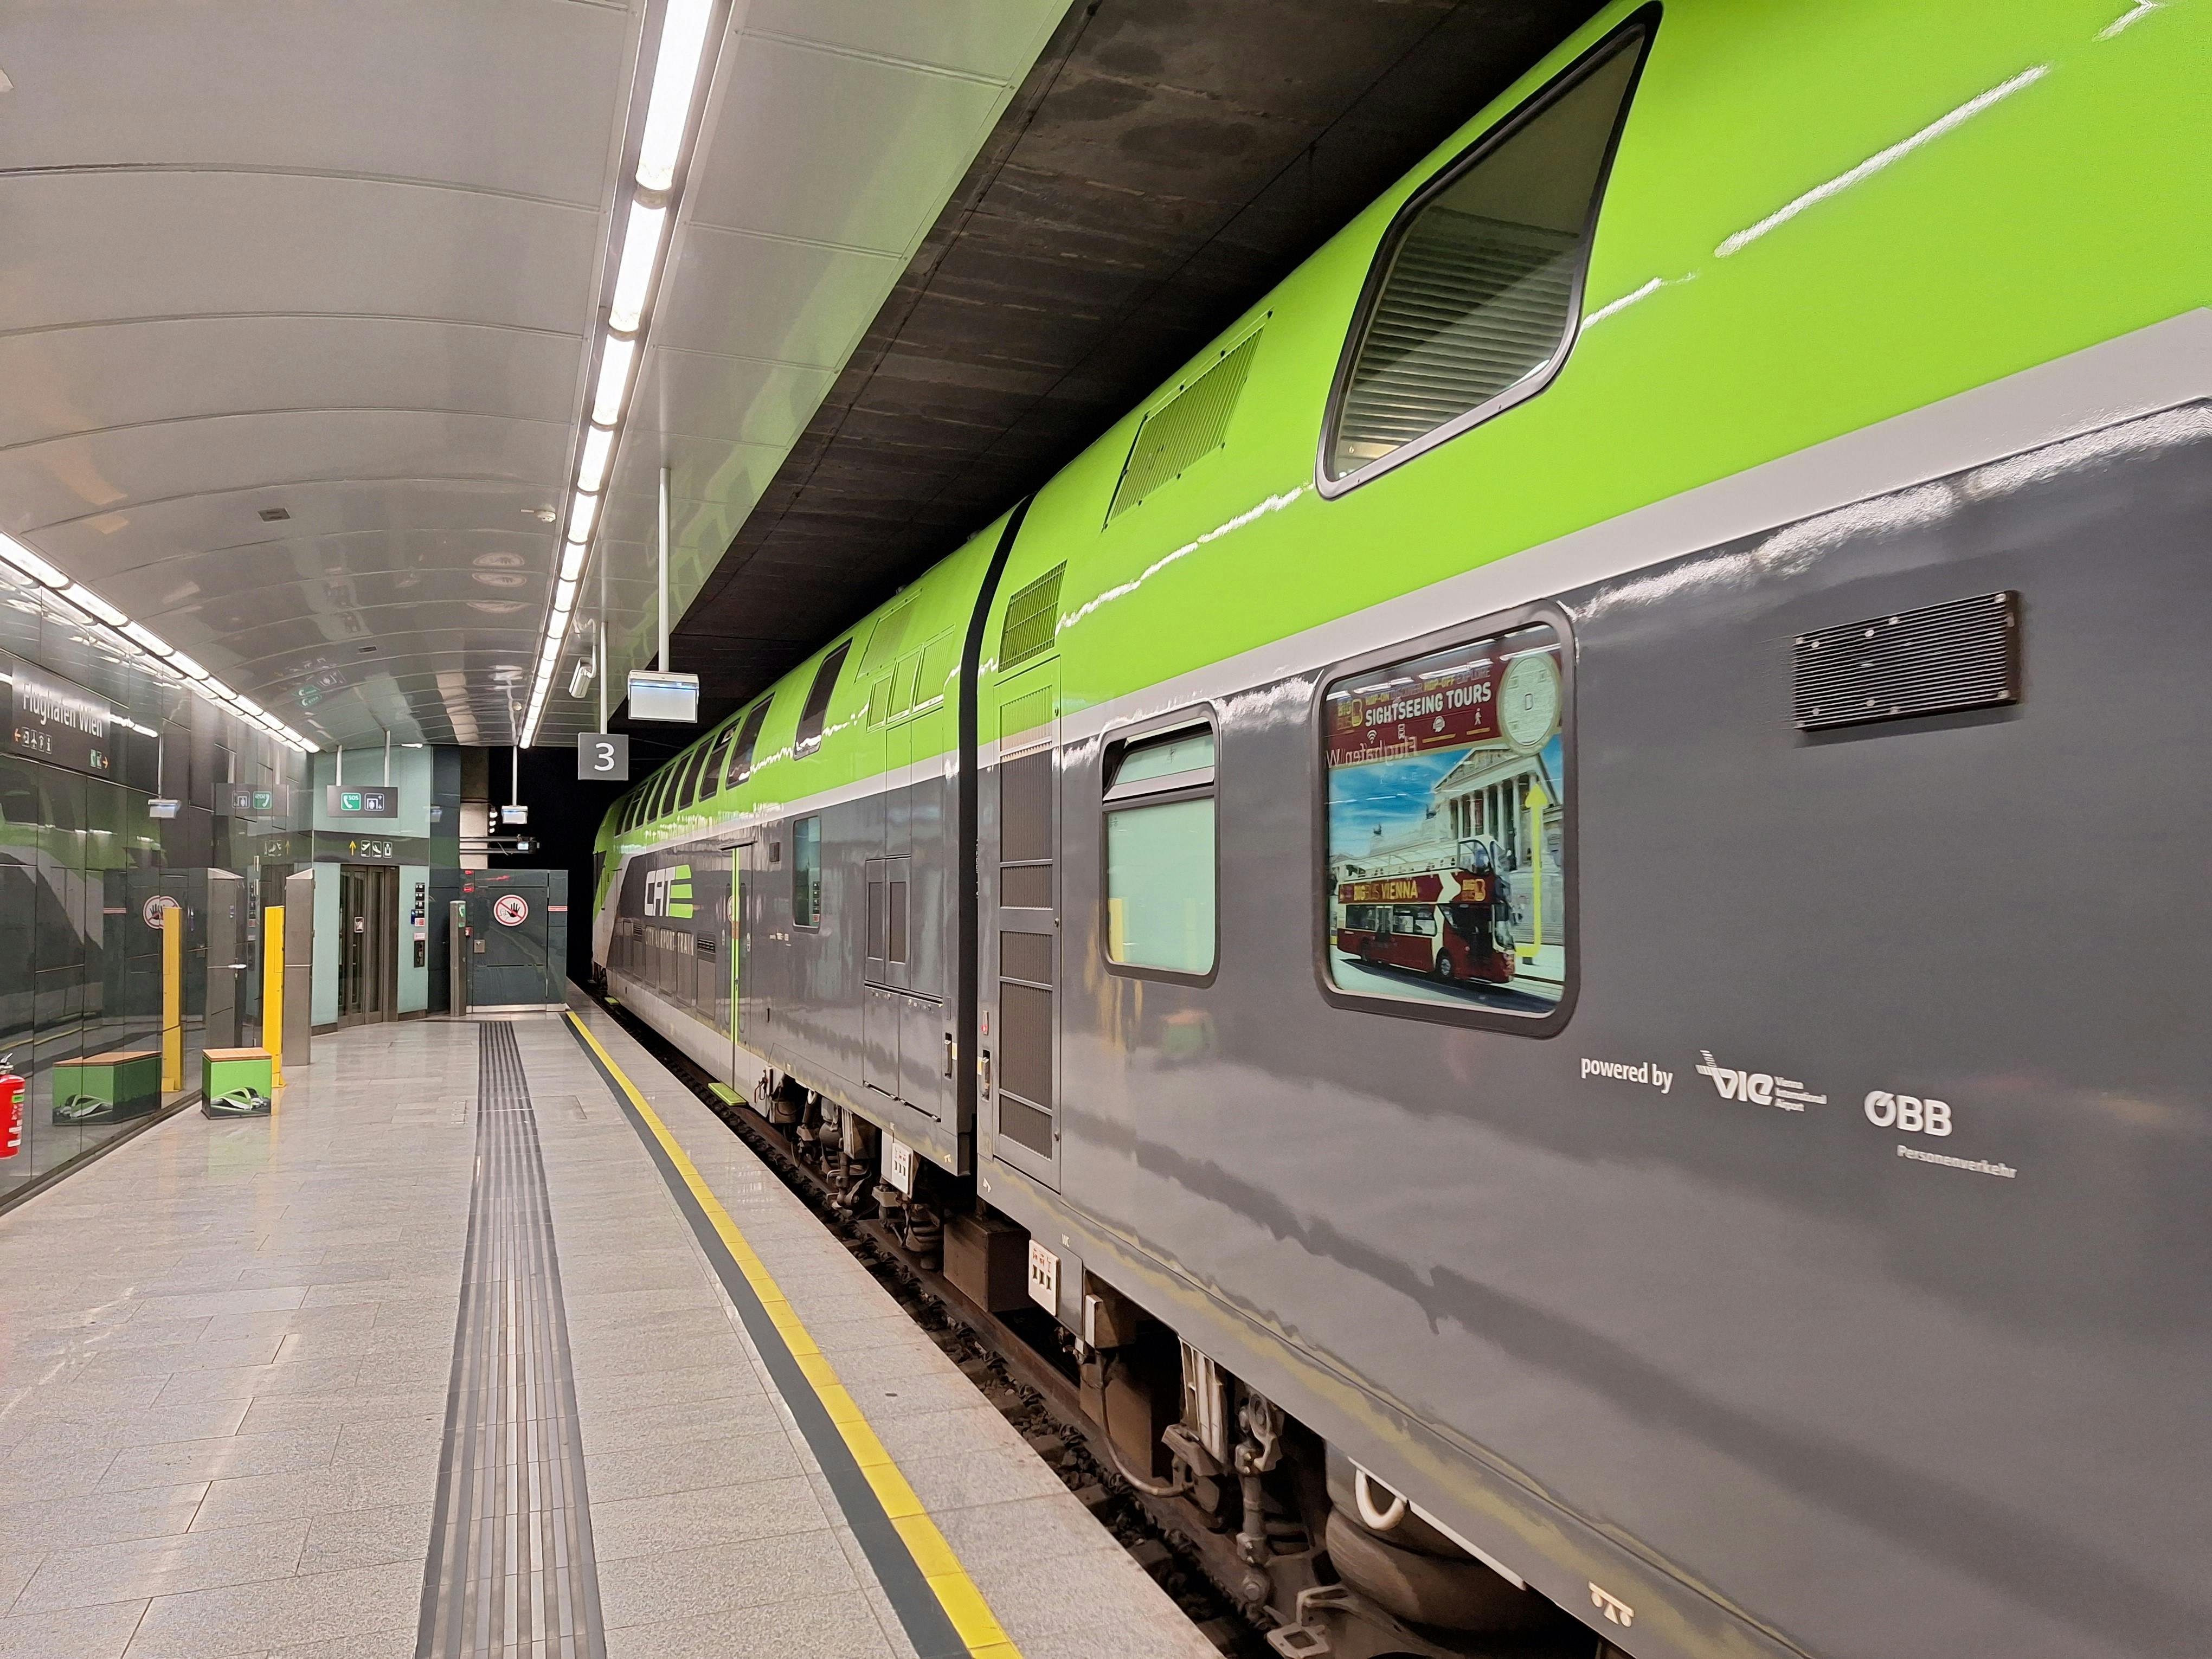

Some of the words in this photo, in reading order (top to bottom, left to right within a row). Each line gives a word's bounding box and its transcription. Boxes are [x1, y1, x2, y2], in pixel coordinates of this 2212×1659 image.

[23, 683, 76, 728] Flughafen
[79, 704, 103, 738] Wien
[1365, 693, 1444, 727] SIGHTSEEING
[1446, 681, 1492, 709] TOURS
[594, 742, 614, 771] 3
[644, 866, 677, 917] CAT
[1382, 880, 1418, 900] VIENNA
[1581, 1058, 1648, 1084] powered
[1652, 1063, 1673, 1094] by
